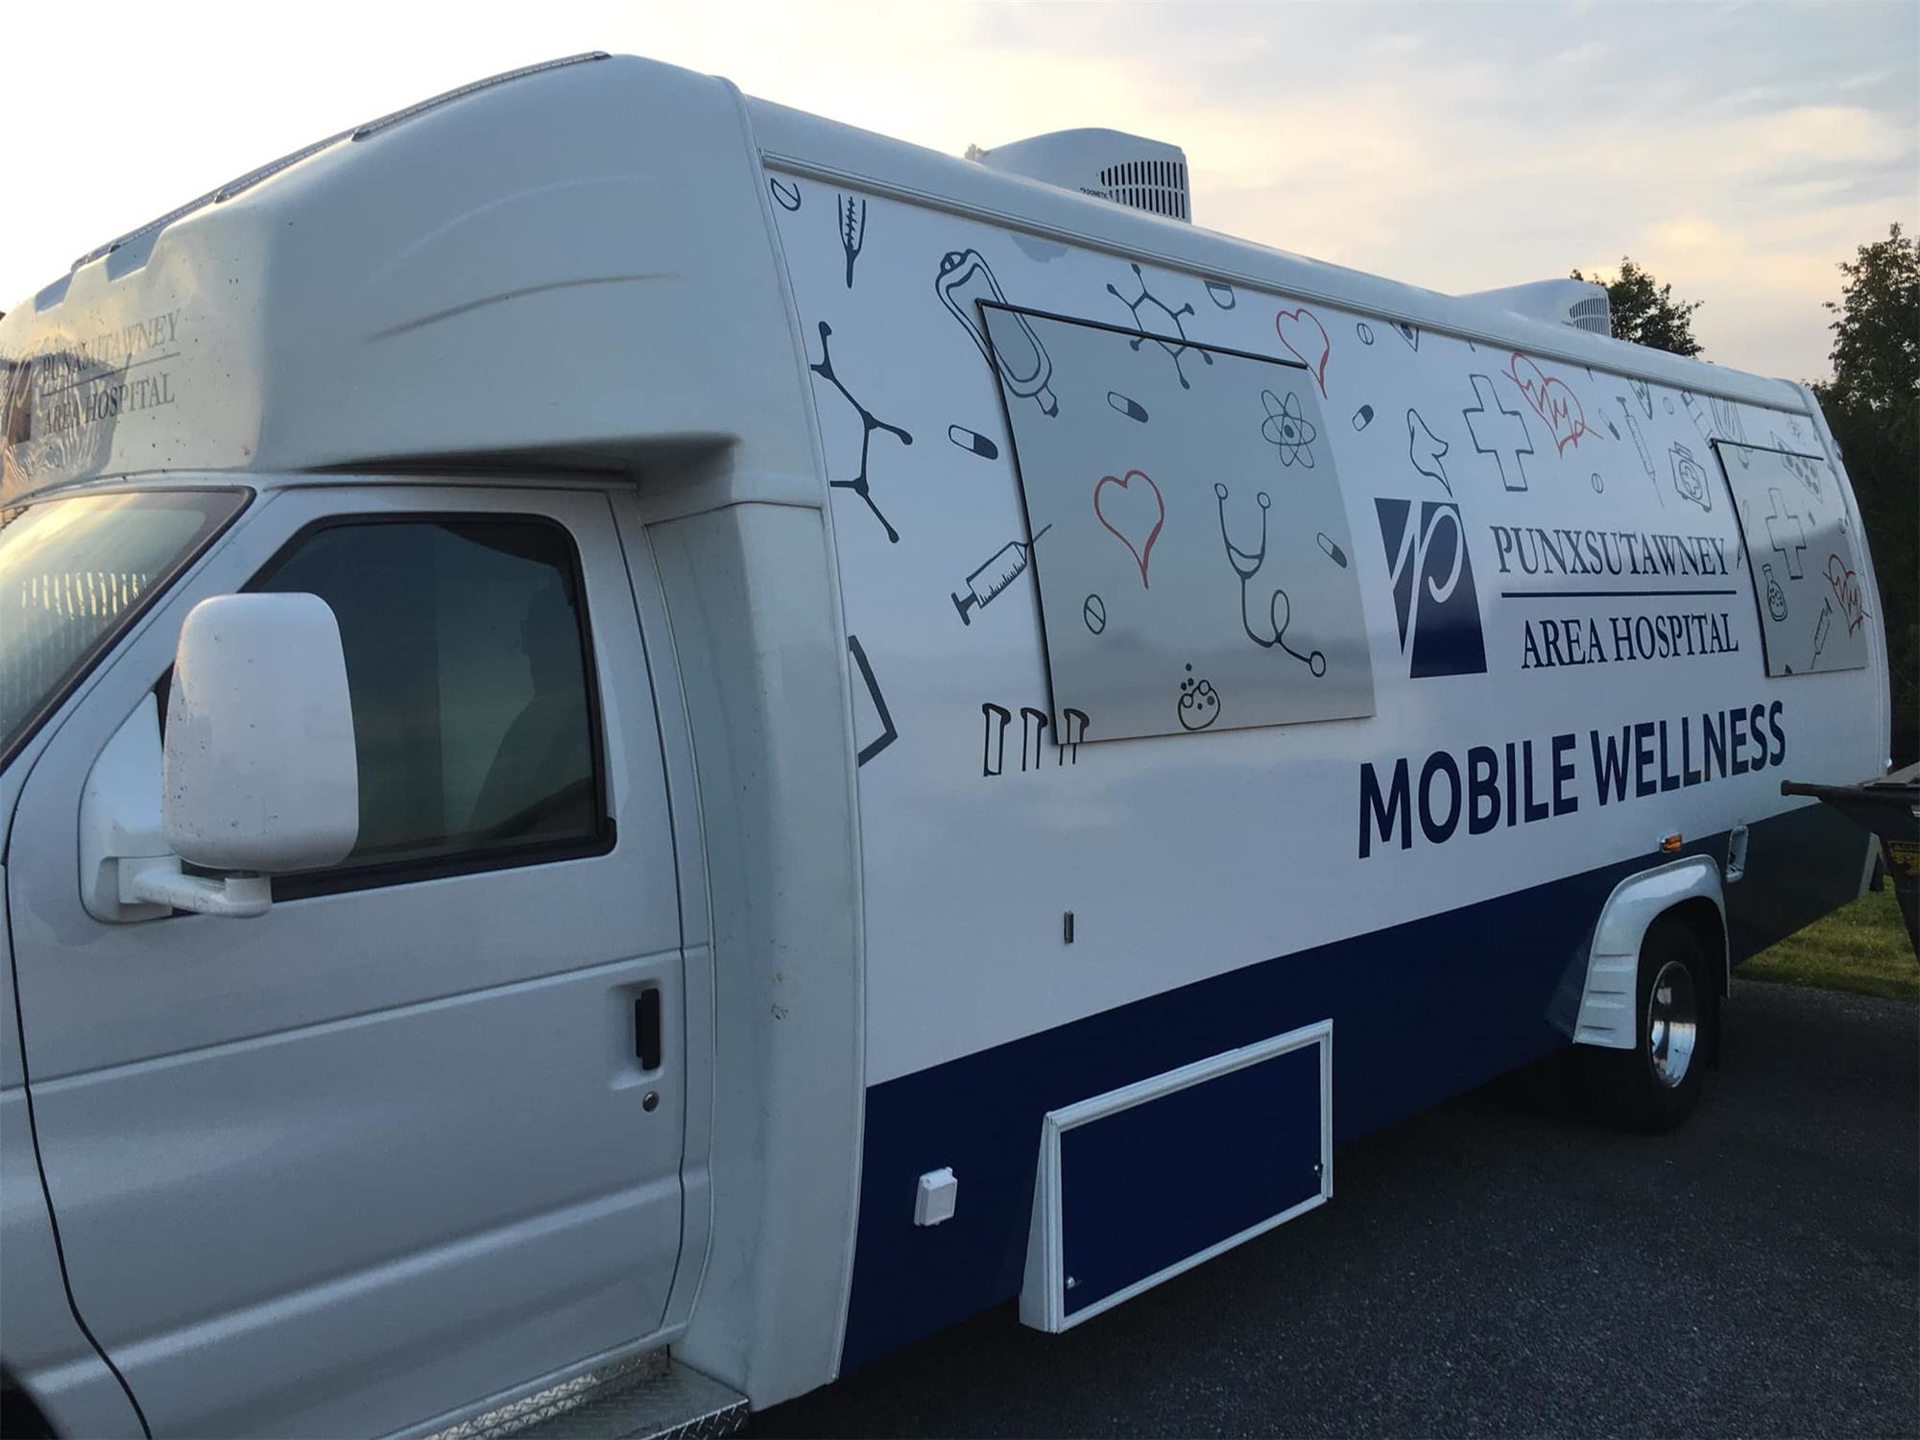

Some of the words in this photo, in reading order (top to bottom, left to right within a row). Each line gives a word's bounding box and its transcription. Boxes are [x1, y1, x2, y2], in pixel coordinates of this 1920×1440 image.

[83, 372, 176, 424] HOSPITAL
[1490, 526, 1729, 576] PUNXSUTAWNEY
[1521, 618, 1607, 669] AREA
[1609, 613, 1739, 662] HOSPITAL
[1359, 733, 1579, 859] MOBILE
[1590, 700, 1786, 806] WELLNESS
